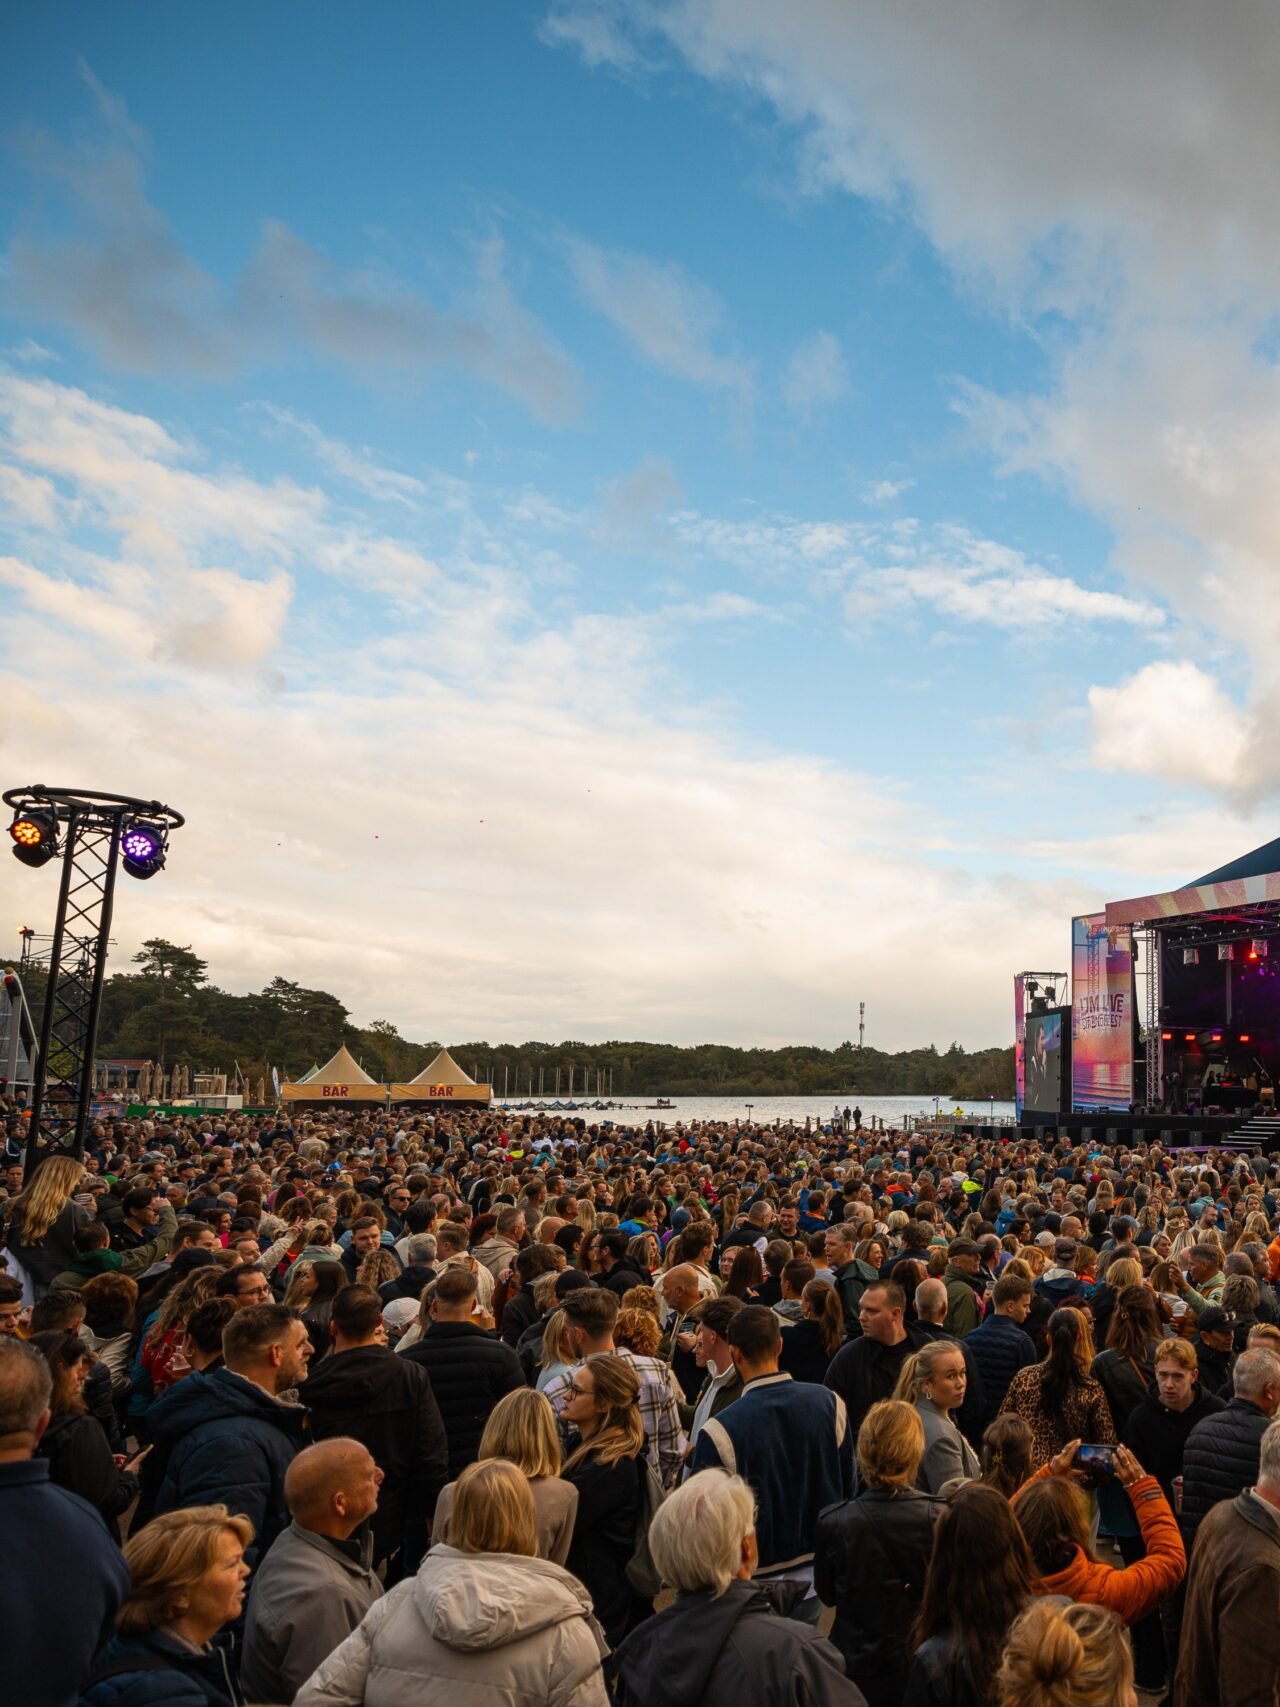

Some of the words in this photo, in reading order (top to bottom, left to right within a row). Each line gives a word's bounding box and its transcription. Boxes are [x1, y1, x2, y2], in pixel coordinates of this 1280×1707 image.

[1102, 993, 1124, 1012] LIVE
[322, 1086, 349, 1097] BAR
[429, 1086, 454, 1097] BAR
